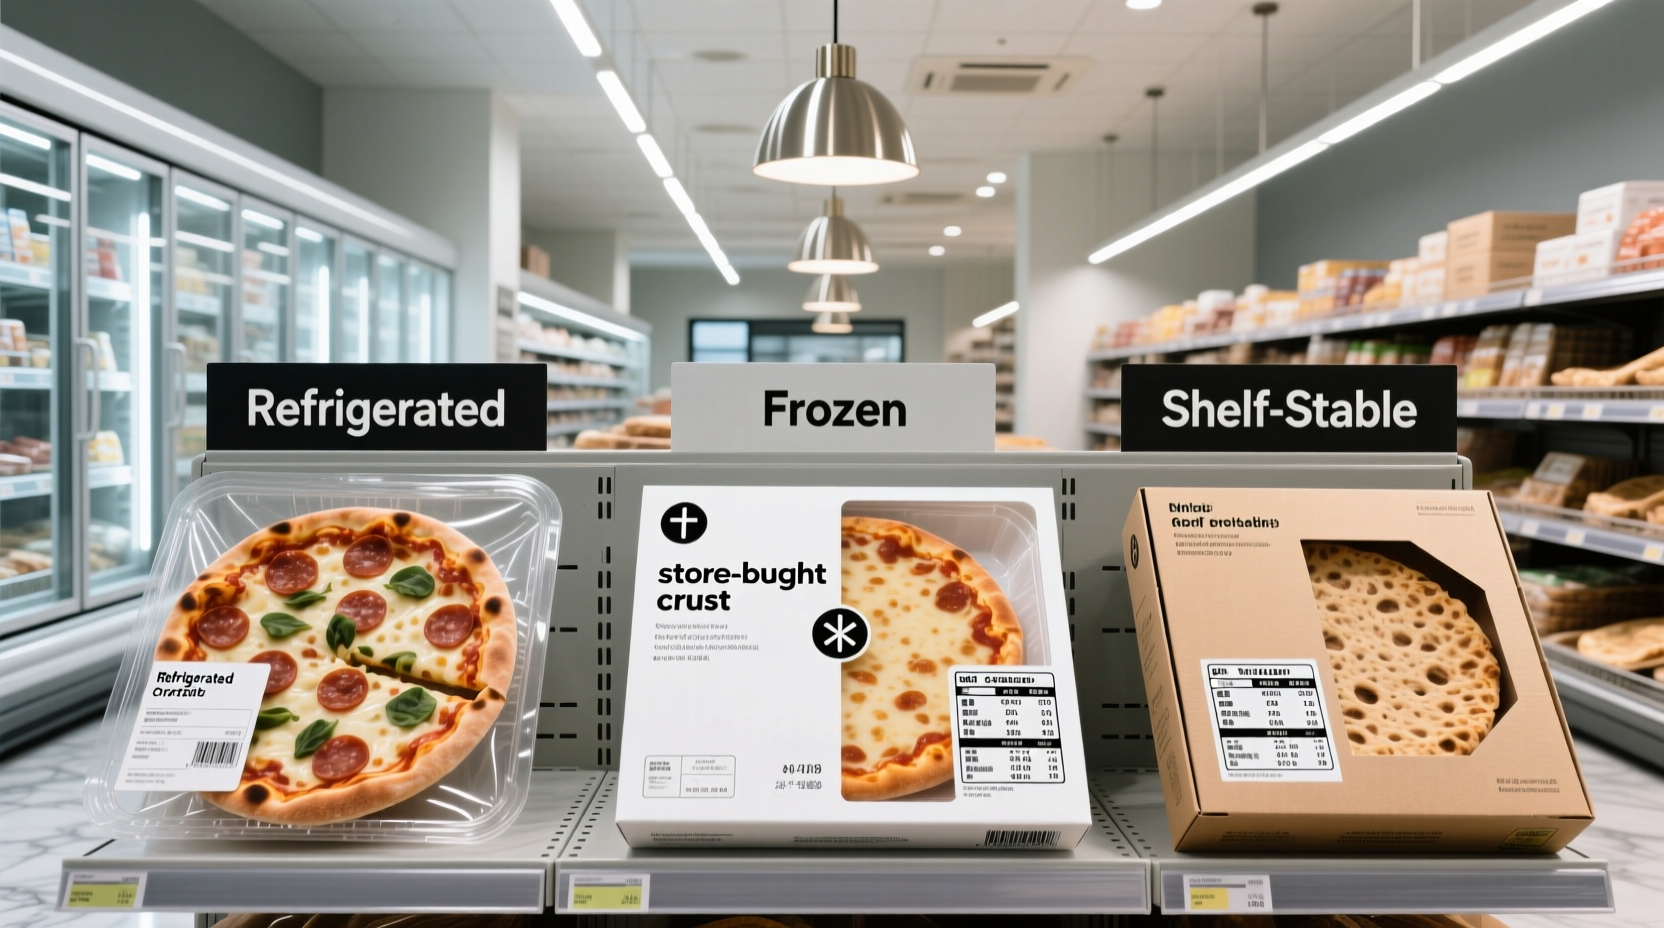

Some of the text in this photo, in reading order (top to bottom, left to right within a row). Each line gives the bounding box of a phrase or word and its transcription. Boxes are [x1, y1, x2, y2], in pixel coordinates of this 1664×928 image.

[249, 388, 505, 437] Refrigerated
[764, 390, 907, 427] Frozen
[1162, 388, 1418, 428] Shelf-Stable
[658, 562, 827, 591] store-bught
[657, 590, 731, 611] crust
